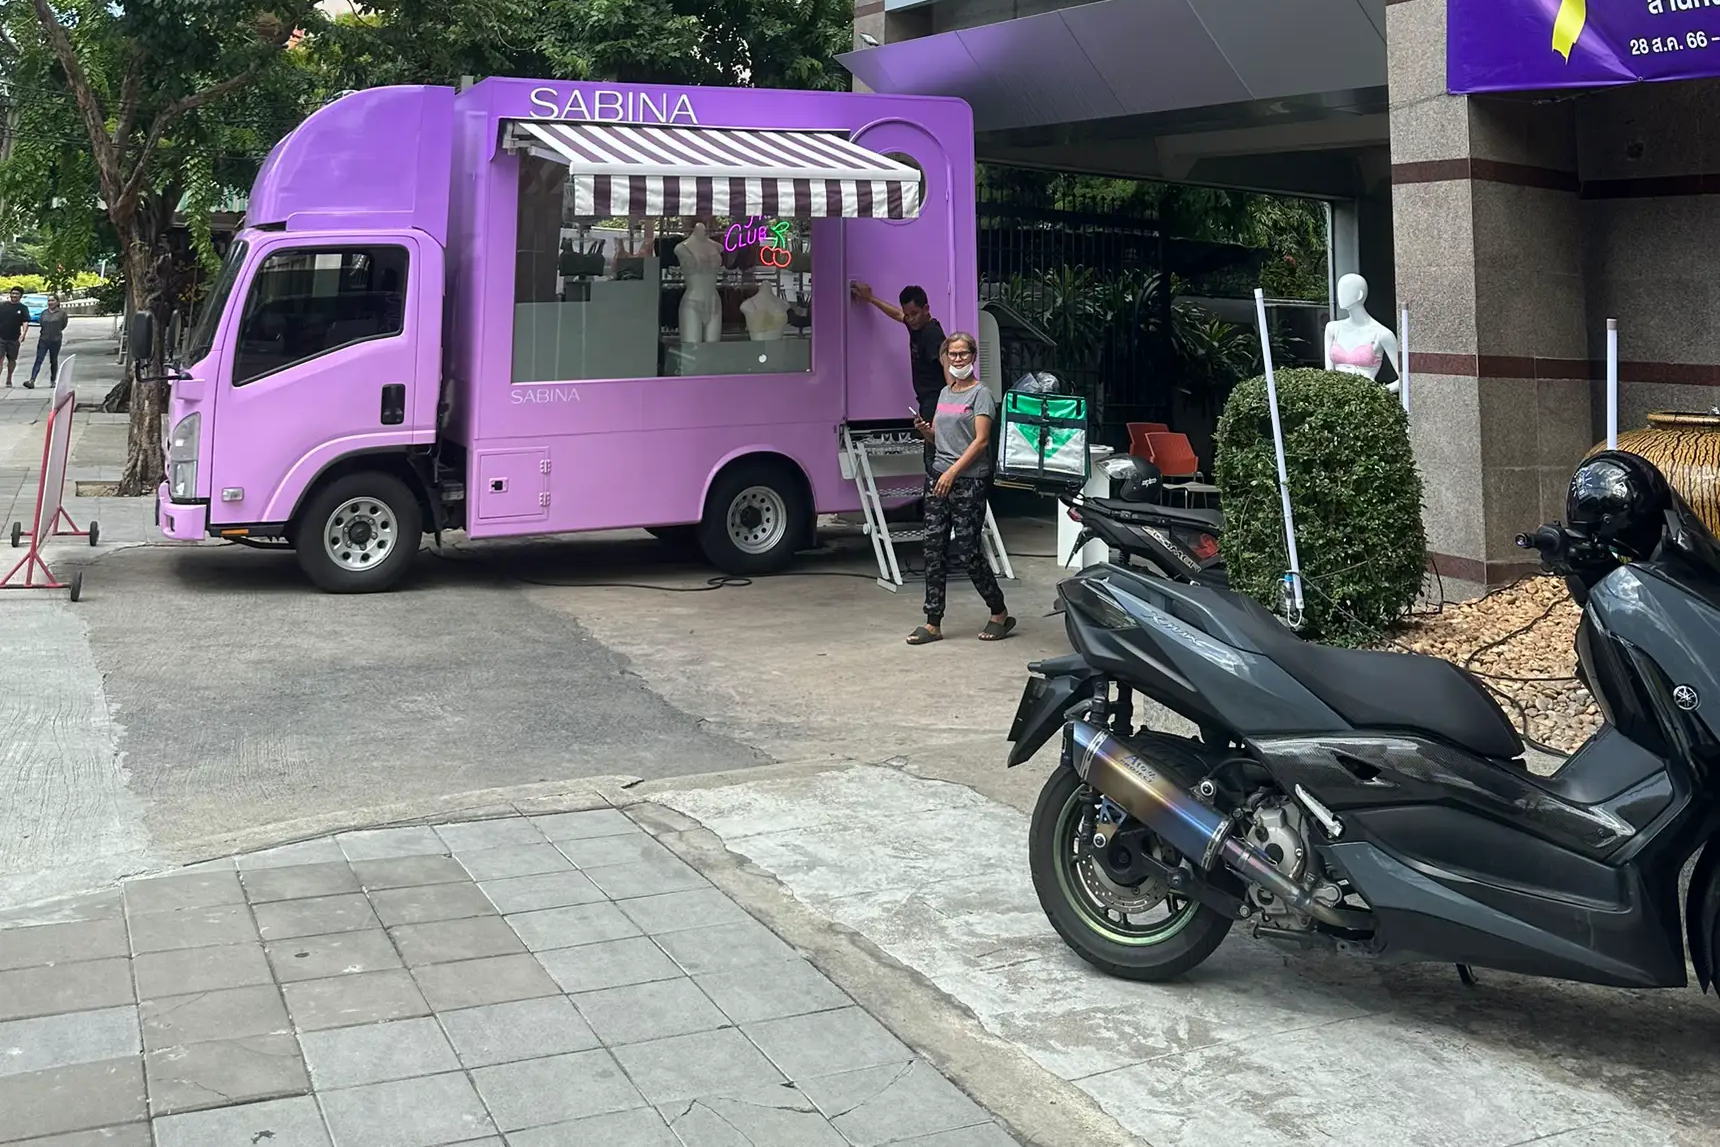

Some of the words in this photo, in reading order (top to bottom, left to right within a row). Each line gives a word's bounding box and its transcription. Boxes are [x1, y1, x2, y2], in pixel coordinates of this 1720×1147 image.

[1630, 38, 1649, 55] 28
[1652, 36, 1684, 53] ส.ค.
[1686, 31, 1708, 49] 66
[529, 87, 699, 125] SABINA
[725, 223, 767, 251] CLUB
[511, 387, 580, 404] SABINA
